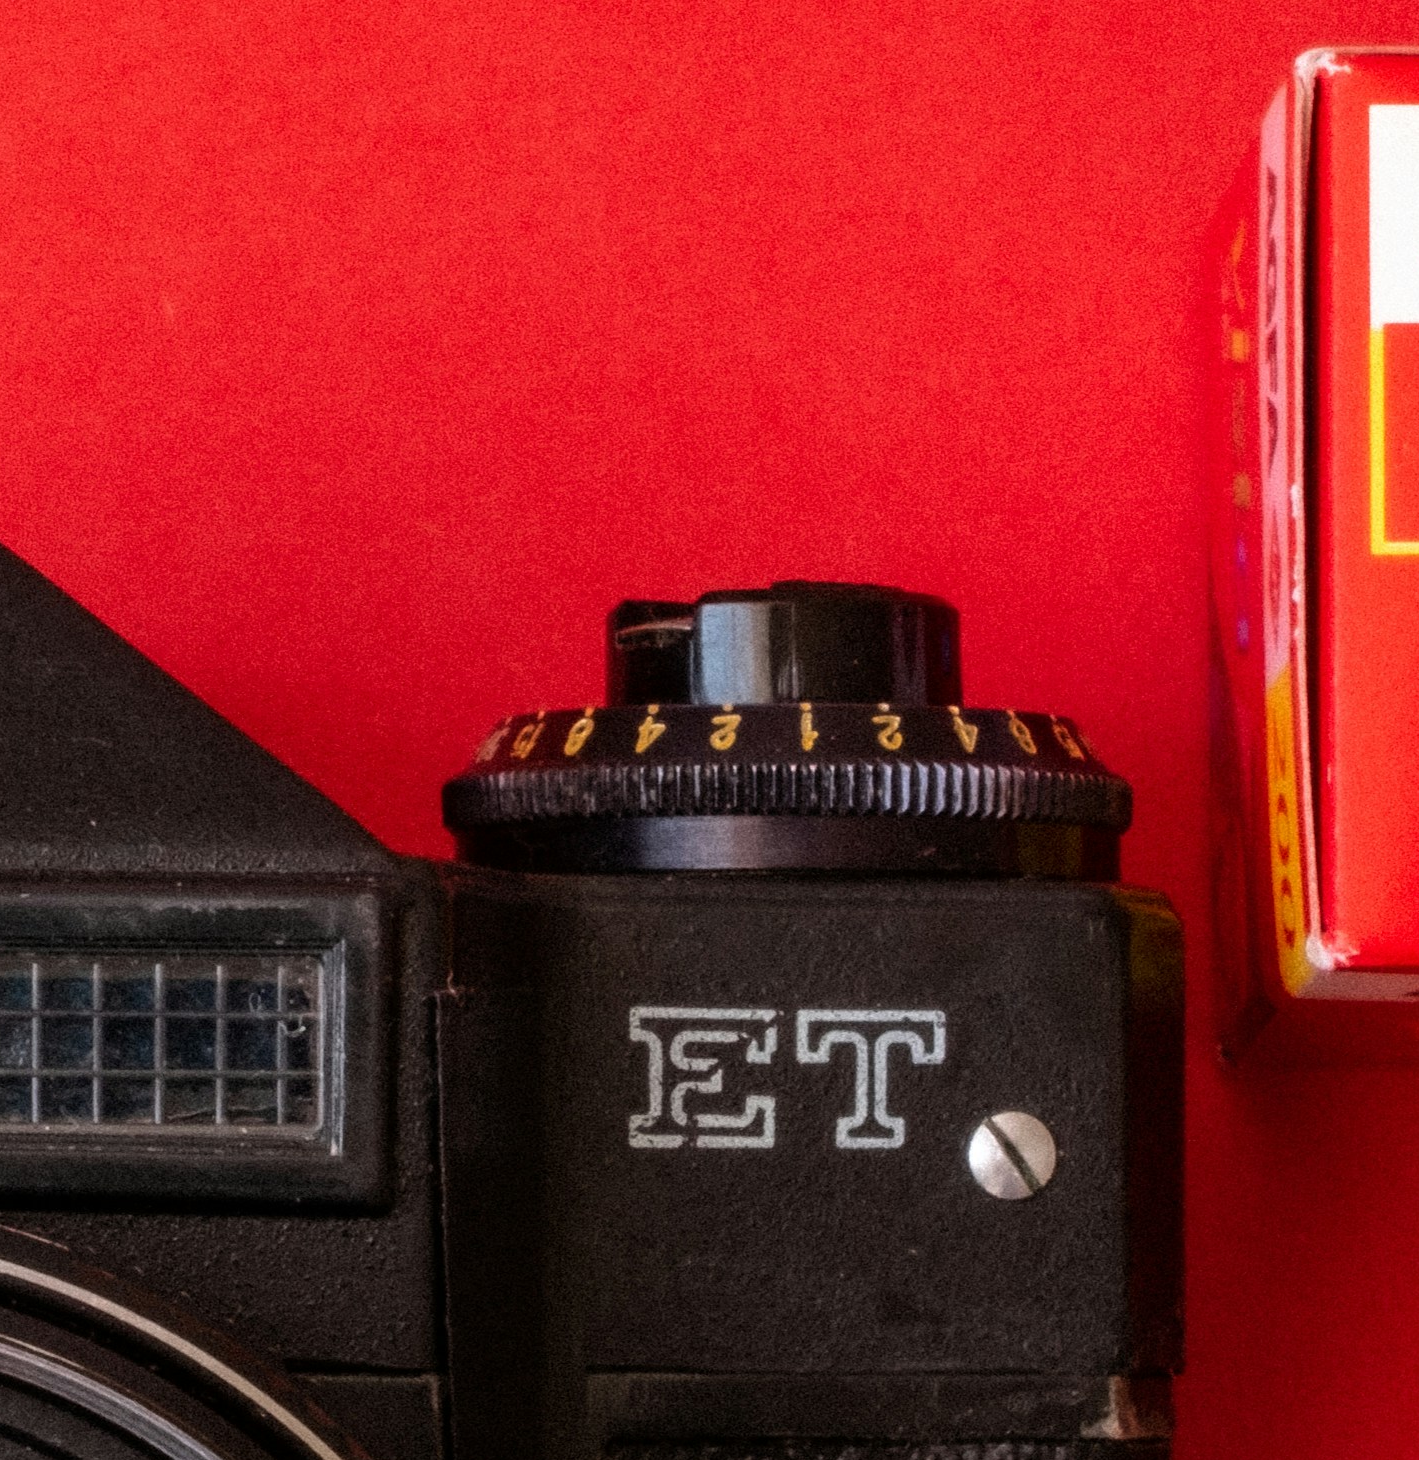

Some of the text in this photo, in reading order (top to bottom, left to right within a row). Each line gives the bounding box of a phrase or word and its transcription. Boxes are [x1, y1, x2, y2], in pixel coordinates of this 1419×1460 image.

[1265, 165, 1279, 477] AGFA
[563, 718, 595, 757] 8
[635, 717, 667, 754] 4
[710, 714, 741, 751] 2
[798, 712, 820, 752] 1
[872, 715, 904, 751] 2
[951, 719, 979, 754] 4
[629, 1006, 946, 1150] ET
